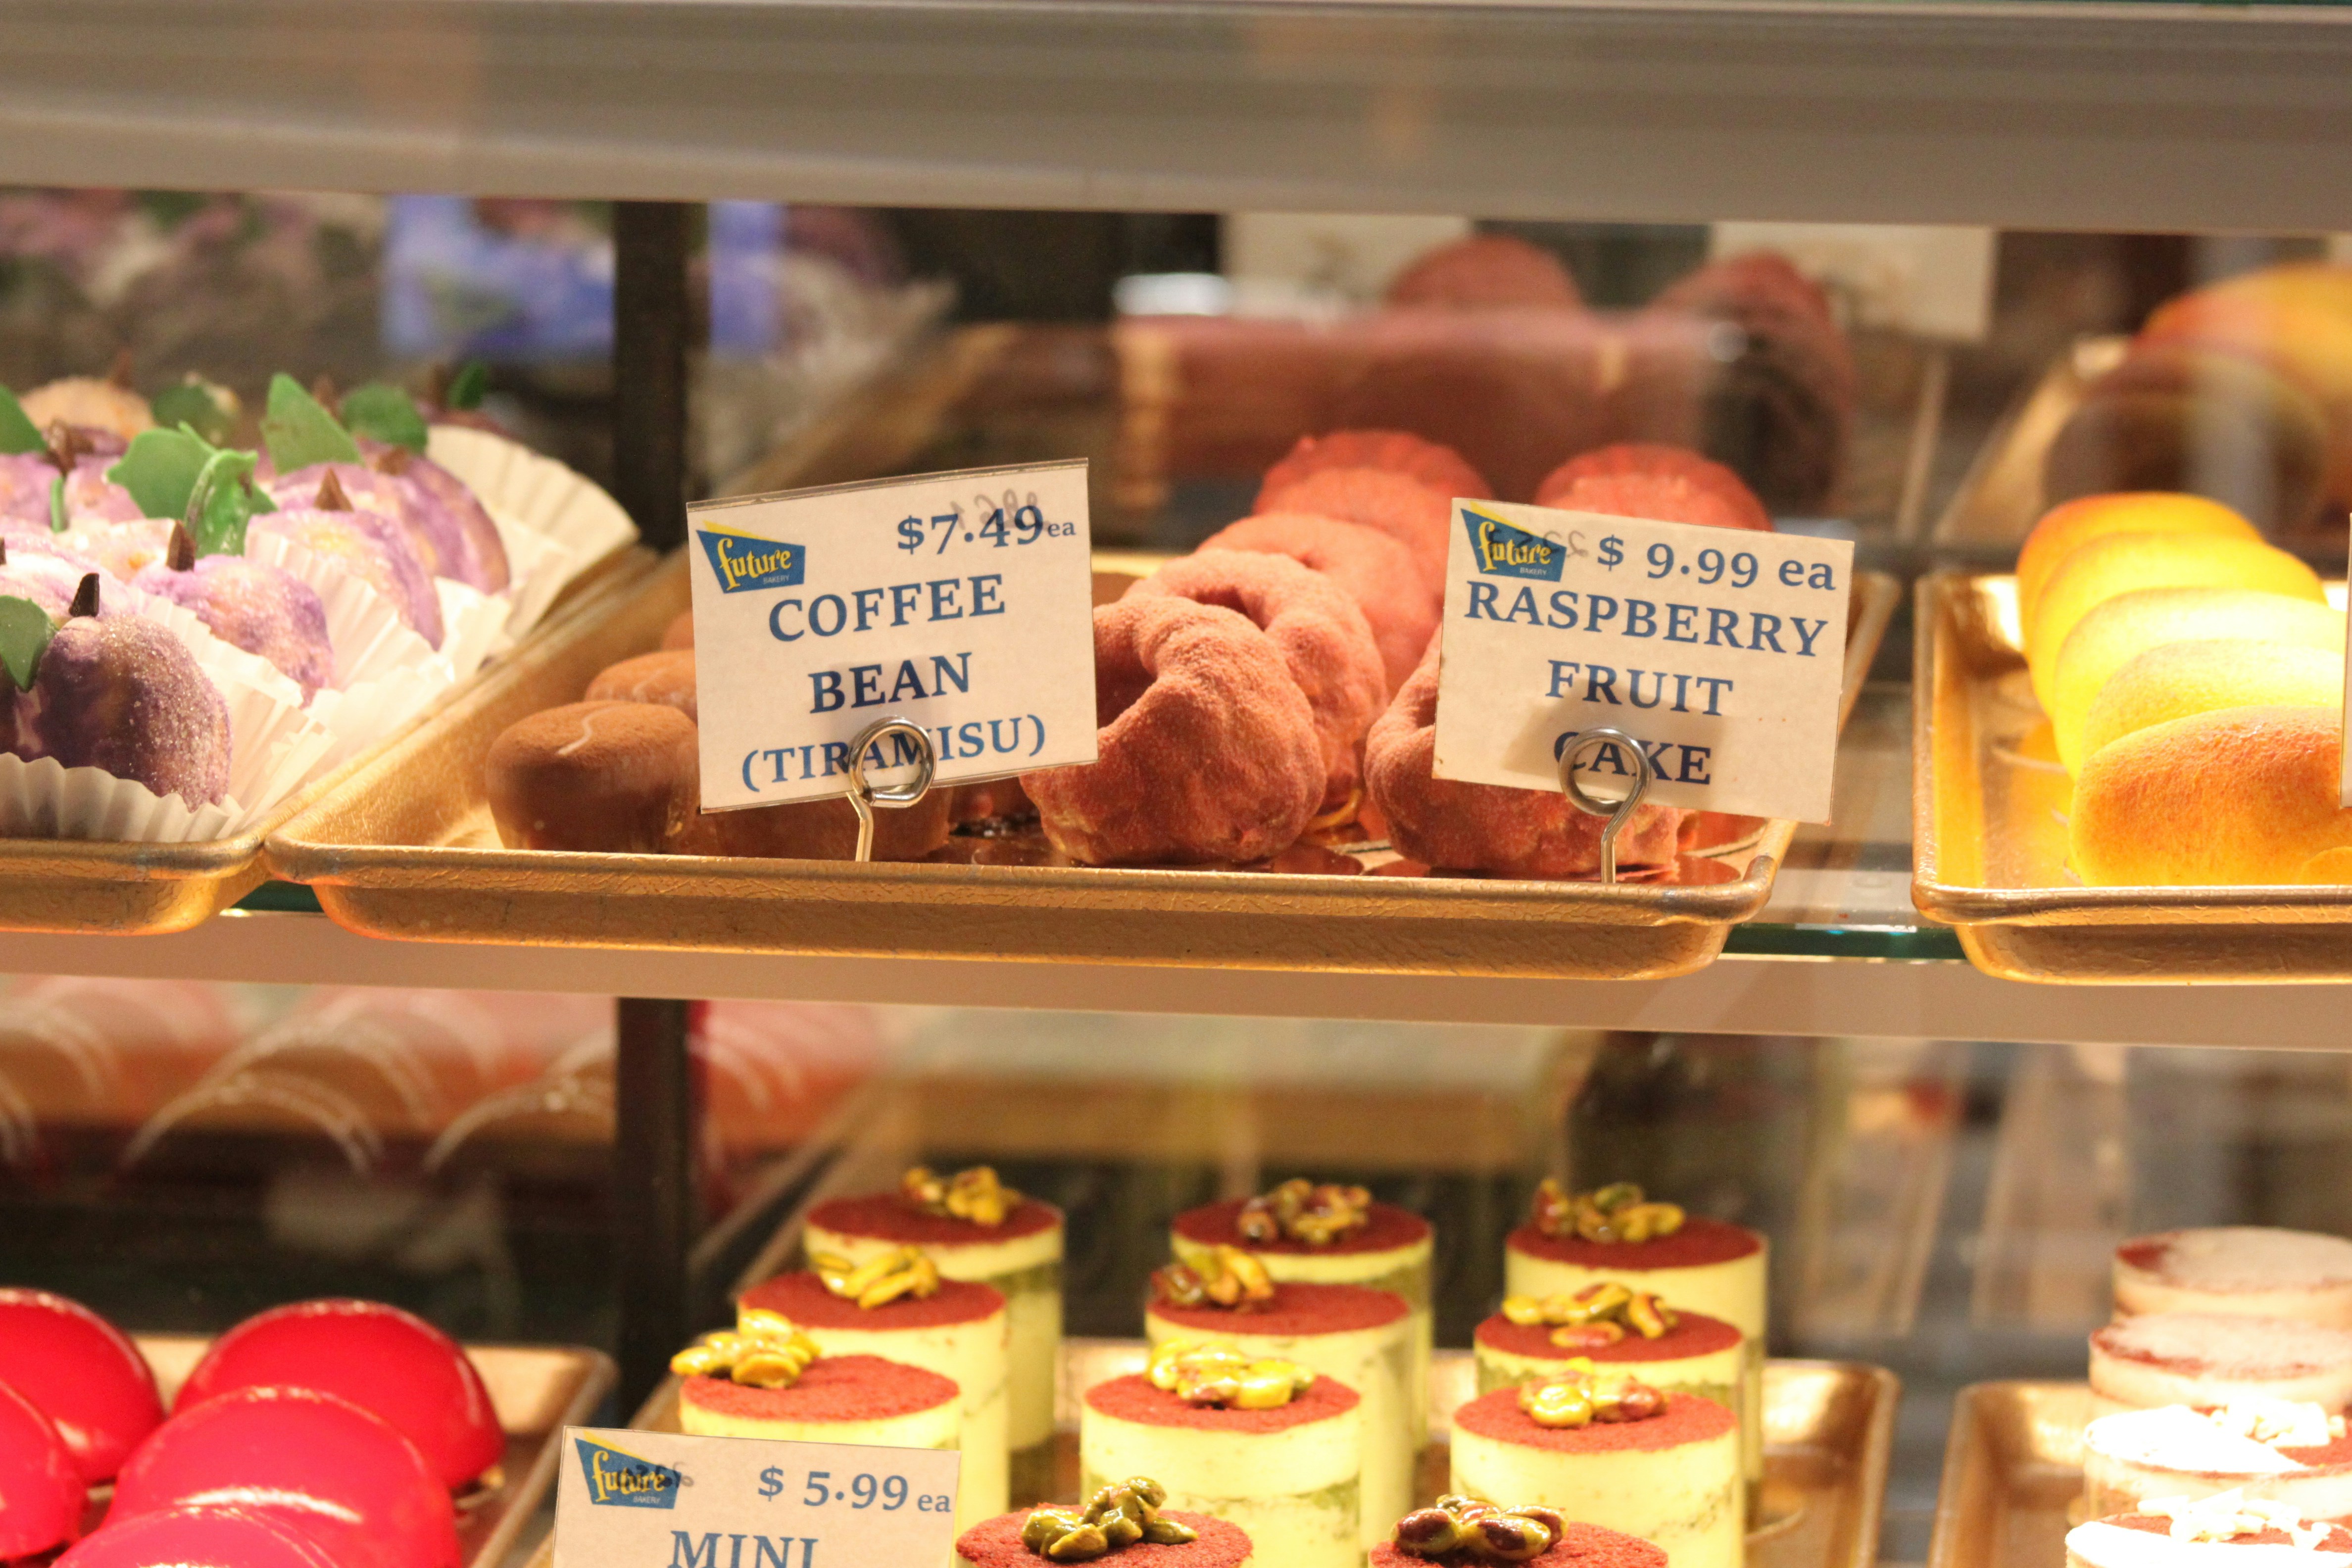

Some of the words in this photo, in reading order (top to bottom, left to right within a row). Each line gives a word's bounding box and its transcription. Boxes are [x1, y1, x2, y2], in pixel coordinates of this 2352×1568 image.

[717, 538, 792, 591] future
[1478, 521, 1552, 572] future
[1519, 566, 1547, 576] BAKERY
[1646, 542, 1760, 588] 9.99
[1778, 558, 1837, 591] ea
[763, 574, 790, 585] BAKERY
[768, 573, 1005, 642] COFFEE
[1464, 580, 1829, 657] RASPBERRY
[807, 651, 973, 714] BEAN
[1545, 659, 1734, 717] FRUIT
[742, 714, 1045, 793] (TIRAMISU)
[592, 1450, 666, 1502] future
[633, 1495, 661, 1504] BAKERY
[803, 1470, 910, 1511] 5.99
[917, 1494, 952, 1514] ea
[667, 1530, 819, 1568] MINI
